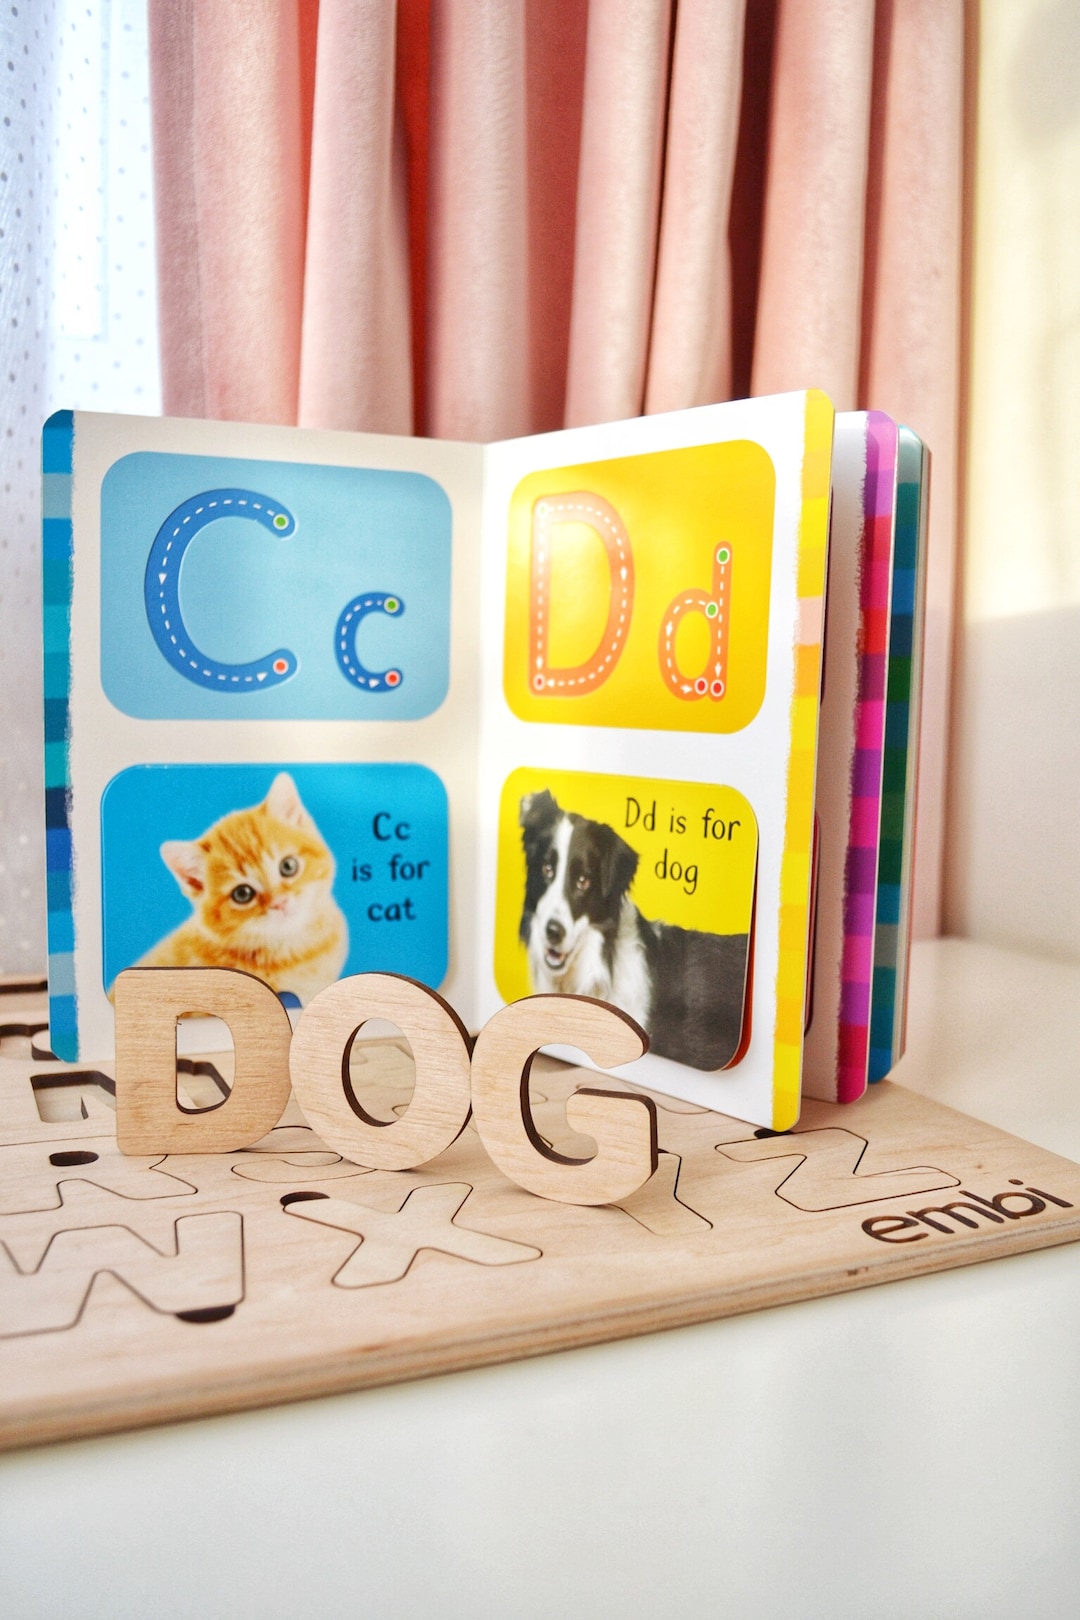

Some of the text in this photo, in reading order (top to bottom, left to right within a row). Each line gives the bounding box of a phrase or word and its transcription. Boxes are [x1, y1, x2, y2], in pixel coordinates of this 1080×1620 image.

[372, 811, 411, 842] Cc
[625, 796, 741, 841] Dd is for
[352, 852, 431, 882] is for
[654, 847, 699, 896] dog
[367, 898, 416, 922] cat
[114, 966, 658, 1208] DOG
[861, 1178, 1074, 1244] embi
